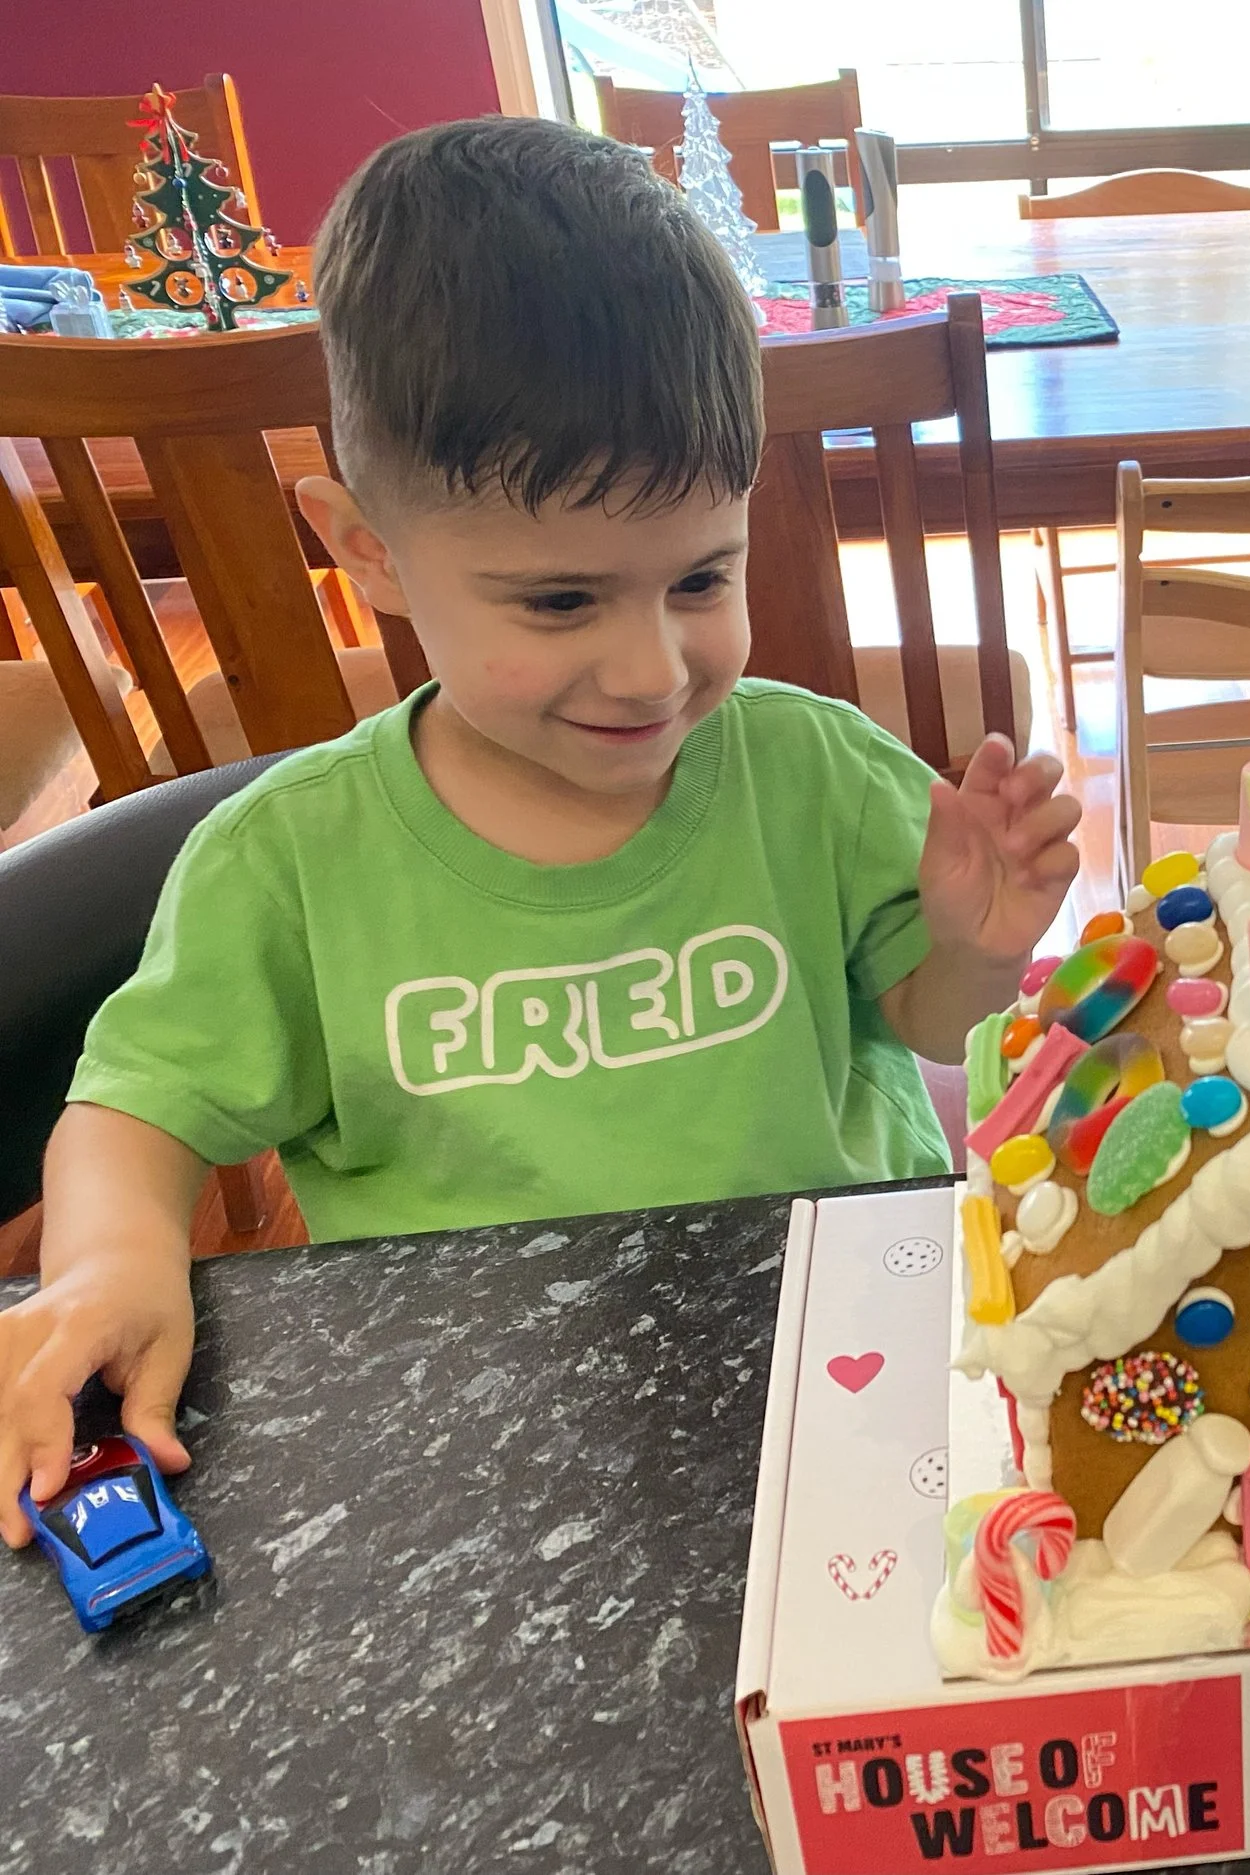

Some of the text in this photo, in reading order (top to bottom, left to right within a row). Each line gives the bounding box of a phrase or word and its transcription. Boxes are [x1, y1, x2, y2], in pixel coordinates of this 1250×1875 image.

[385, 924, 788, 1096] FRED
[812, 1734, 902, 1758] ST MARY'S
[814, 1731, 1118, 1815] HOUSE OF
[910, 1781, 1221, 1860] WELCOME
